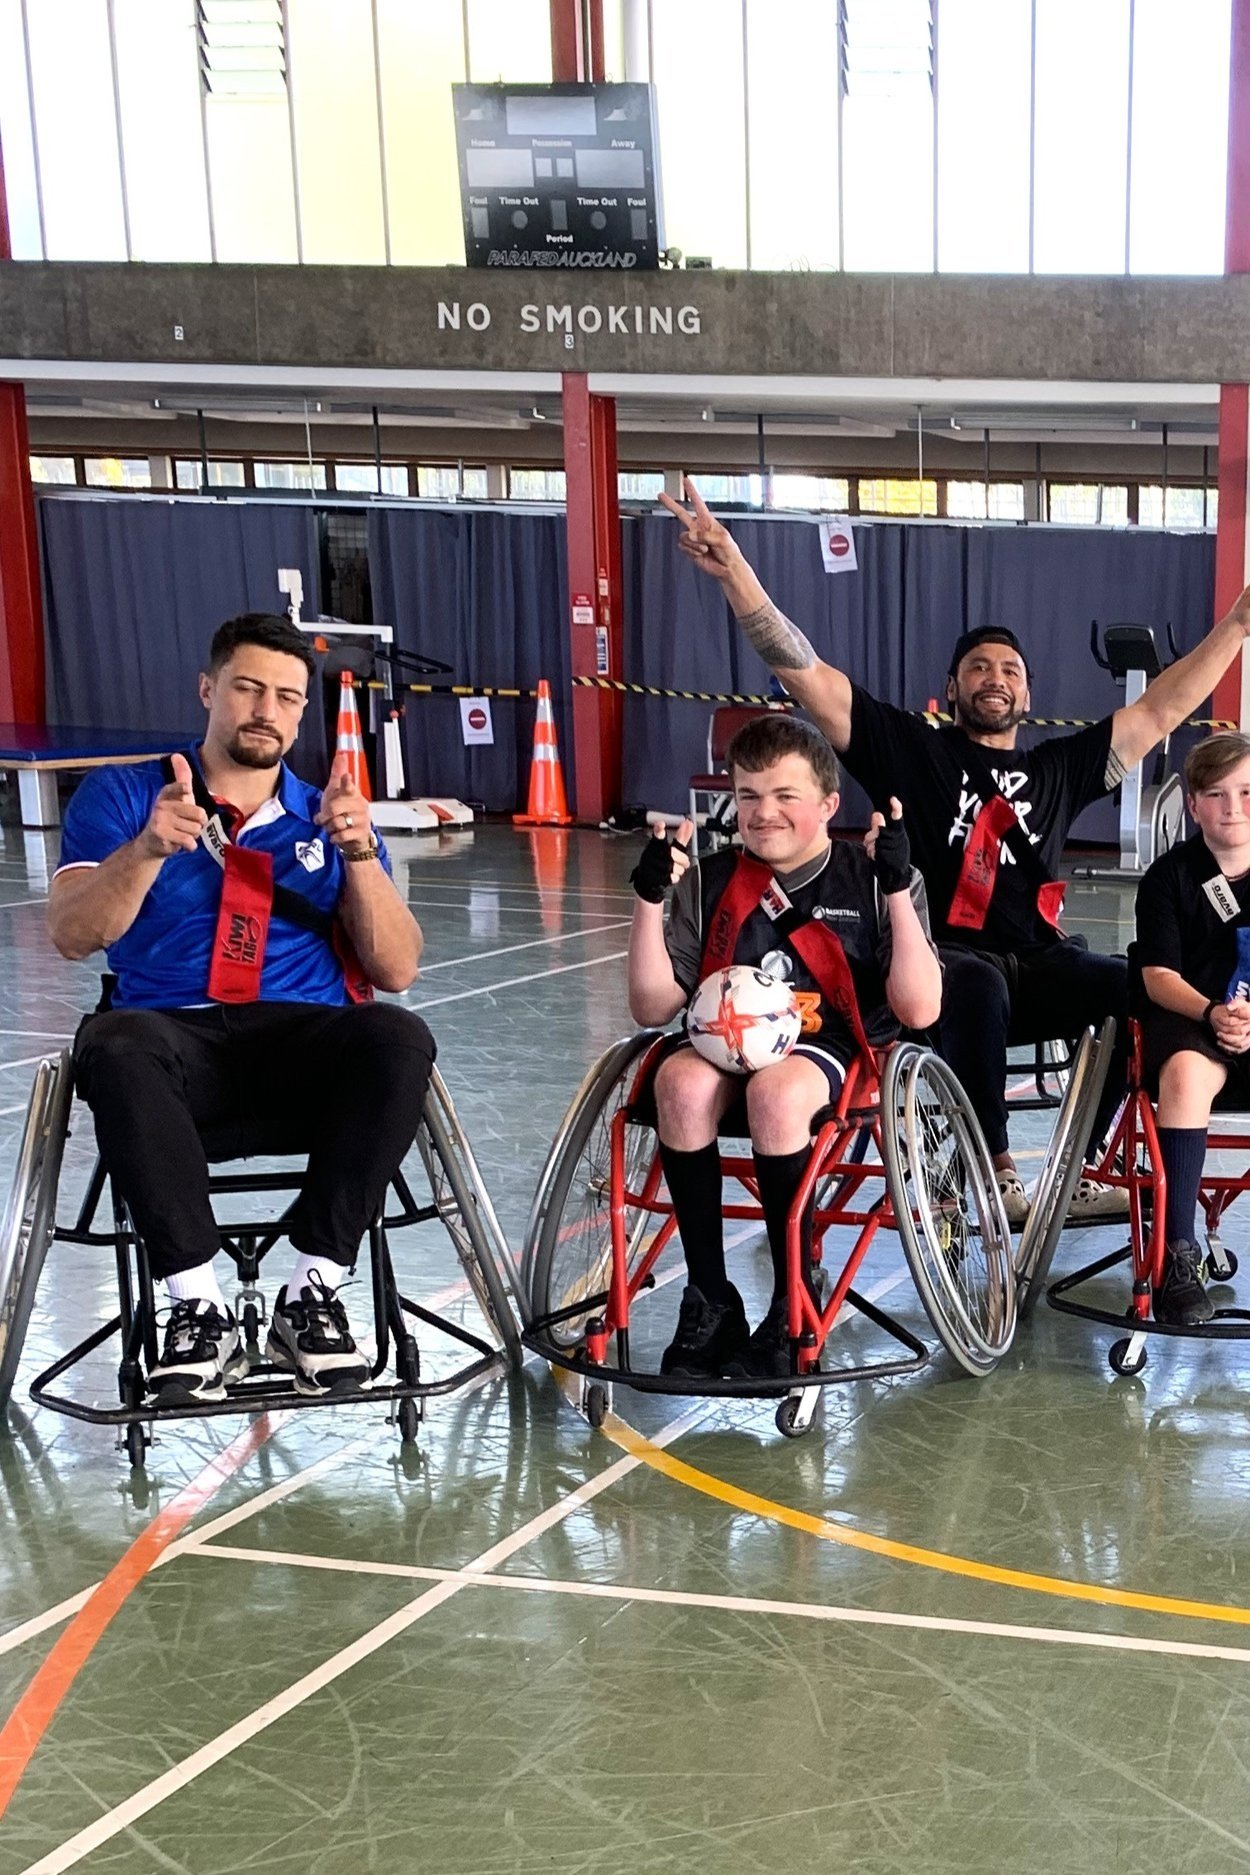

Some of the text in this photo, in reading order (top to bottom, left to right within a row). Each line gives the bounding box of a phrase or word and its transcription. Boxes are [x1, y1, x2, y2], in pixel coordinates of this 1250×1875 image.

[611, 139, 635, 150] Away
[469, 197, 488, 205] Foul
[499, 197, 539, 206] Time Out
[577, 197, 617, 207] Time Out
[627, 198, 646, 207] Foul
[546, 234, 573, 244] Period
[437, 302, 701, 335] NO SMOKING
[1212, 884, 1235, 917] avaro
[825, 907, 860, 917] BASKETBALL
